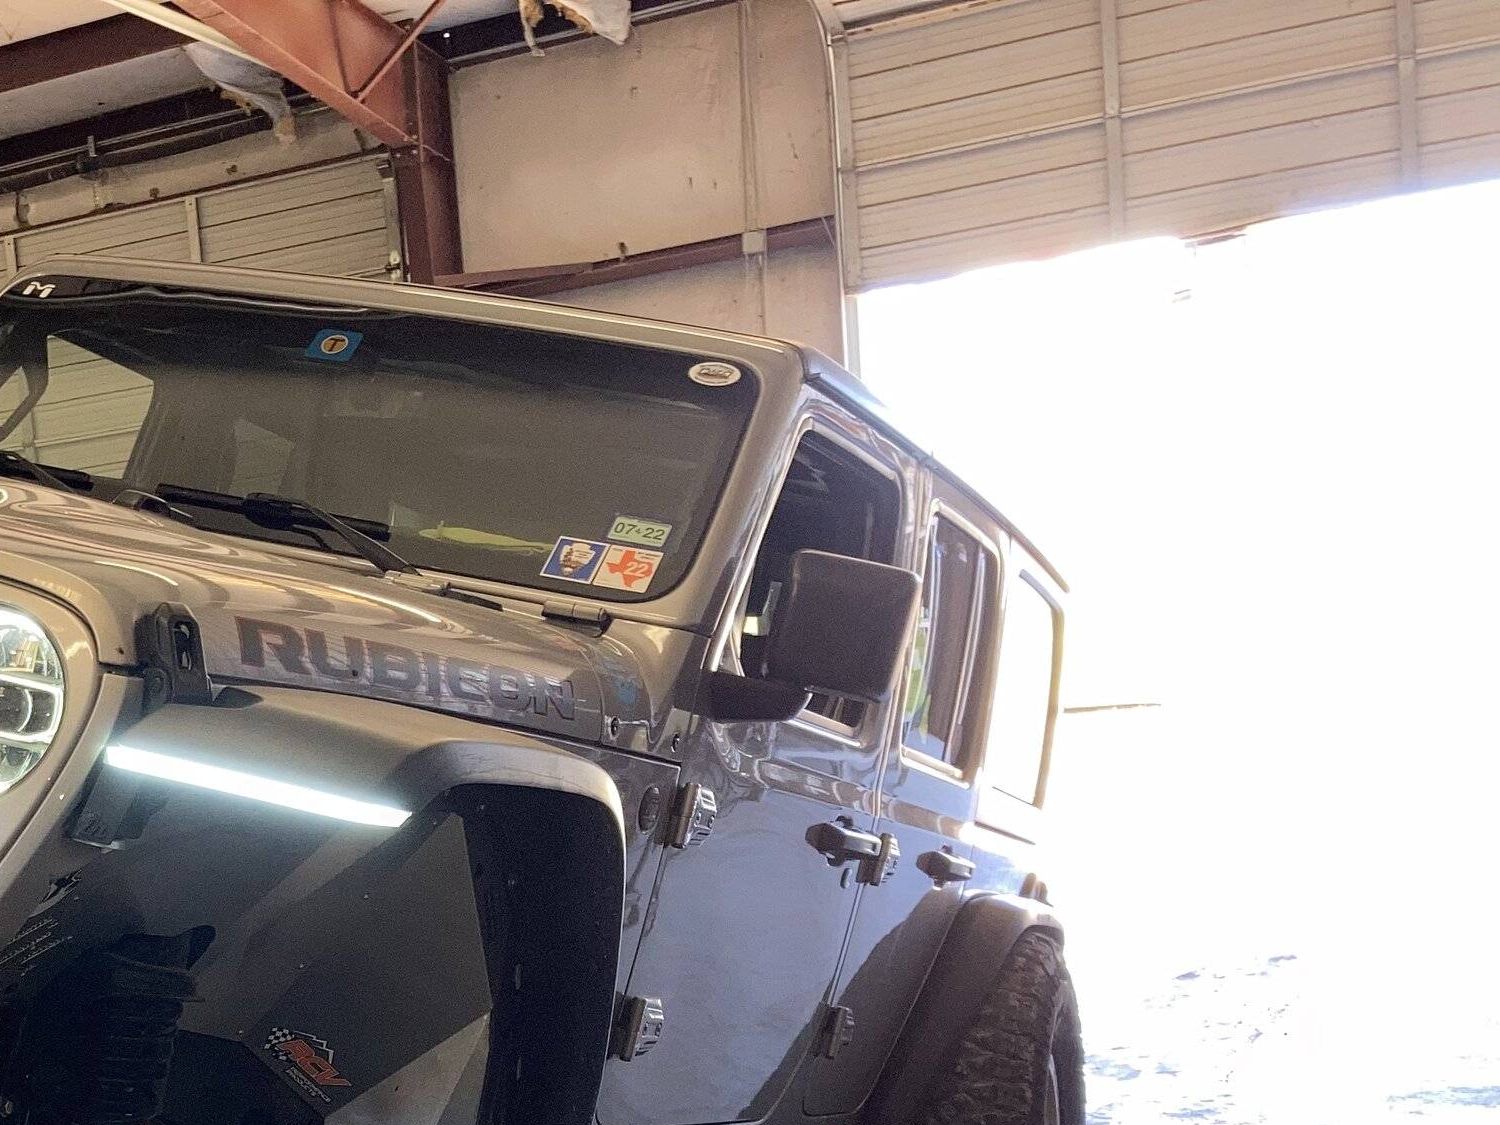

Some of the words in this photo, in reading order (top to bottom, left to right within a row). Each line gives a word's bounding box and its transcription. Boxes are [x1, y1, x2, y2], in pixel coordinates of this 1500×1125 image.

[614, 522, 637, 535] 07
[642, 527, 665, 540] 22
[624, 561, 648, 577] 22
[234, 615, 576, 721] RUBICON
